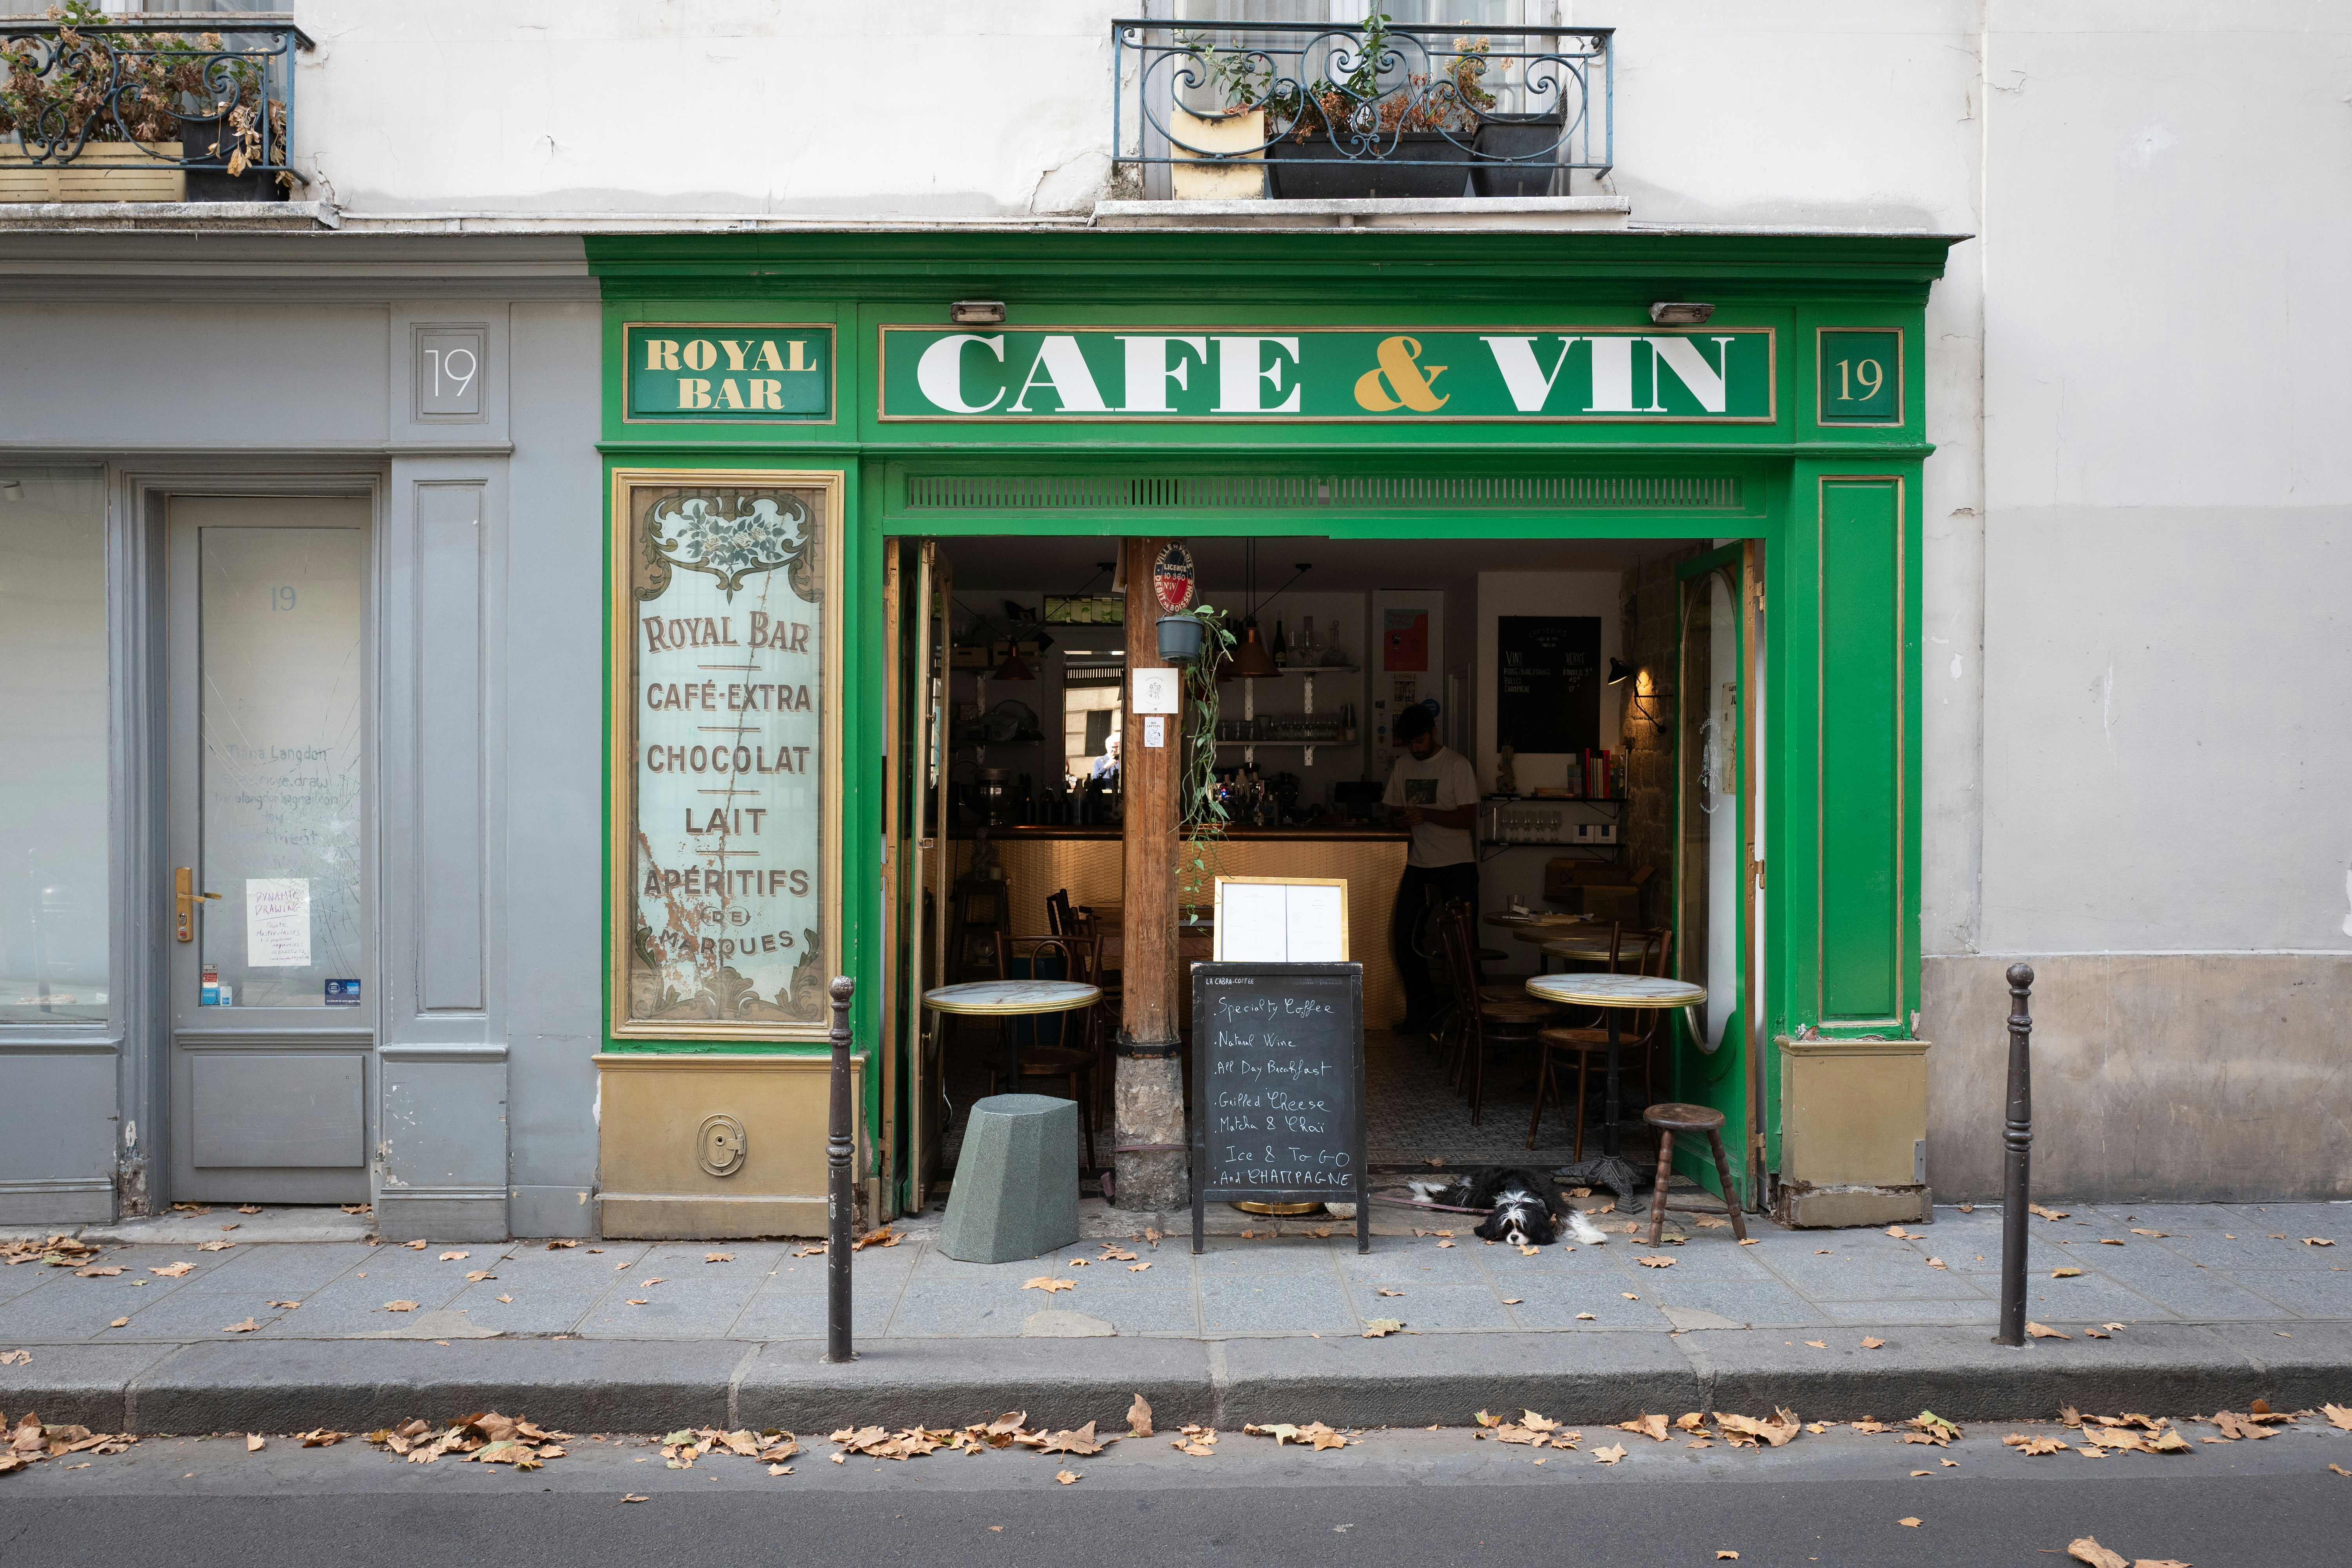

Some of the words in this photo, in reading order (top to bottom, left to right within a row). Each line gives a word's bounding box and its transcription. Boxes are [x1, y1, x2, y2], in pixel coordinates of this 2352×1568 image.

[645, 339, 817, 371] ROYAL
[425, 348, 476, 397] 19
[917, 334, 1301, 413] CAFE
[1354, 336, 1450, 412] &
[1478, 336, 1735, 412] VIN
[1836, 359, 1883, 401] 19
[677, 378, 785, 410] BAR
[1156, 543, 1173, 564] VILLE
[1164, 564, 1187, 572] LICENCE
[270, 586, 297, 611] 19
[1155, 575, 1166, 601] DEBIT
[1170, 579, 1193, 612] BOISSONS
[642, 615, 740, 655] ROYAL
[747, 611, 811, 654] BAR
[1528, 628, 1567, 638] CAUSERIES
[1506, 651, 1523, 665] VINS
[1566, 652, 1586, 663] VERRE
[647, 680, 813, 712] CAFÉ-EXTRA
[1504, 685, 1530, 693] CHAMPAGNE
[1700, 719, 1720, 734] CAUSERIES
[271, 744, 327, 766] Langdon
[647, 744, 810, 774] CHOCOLAT
[686, 808, 767, 835] LAIT
[644, 865, 810, 897] APÉRITIFS
[254, 890, 300, 903] DYNAMIC
[255, 903, 301, 915] DRAWING
[713, 911, 743, 923] DE
[660, 929, 795, 956] MARQUES
[1219, 997, 1278, 1022] Specialty
[1285, 998, 1335, 1018] Coffee
[1219, 1031, 1254, 1047] Natural
[1263, 1032, 1296, 1047] Wine
[1218, 1061, 1233, 1074] All
[1242, 1062, 1262, 1082] Day
[1268, 1060, 1332, 1080] Breakfast
[1219, 1092, 1260, 1108] Grilled
[1267, 1090, 1332, 1112] Cheese
[1221, 1116, 1259, 1131] Matcha
[1267, 1116, 1276, 1130] &
[1225, 1145, 1253, 1163] Ice
[1265, 1145, 1275, 1162] &
[1289, 1147, 1312, 1161] To
[1221, 1172, 1240, 1185] And
[1249, 1169, 1353, 1185] CHAMPAGNE
